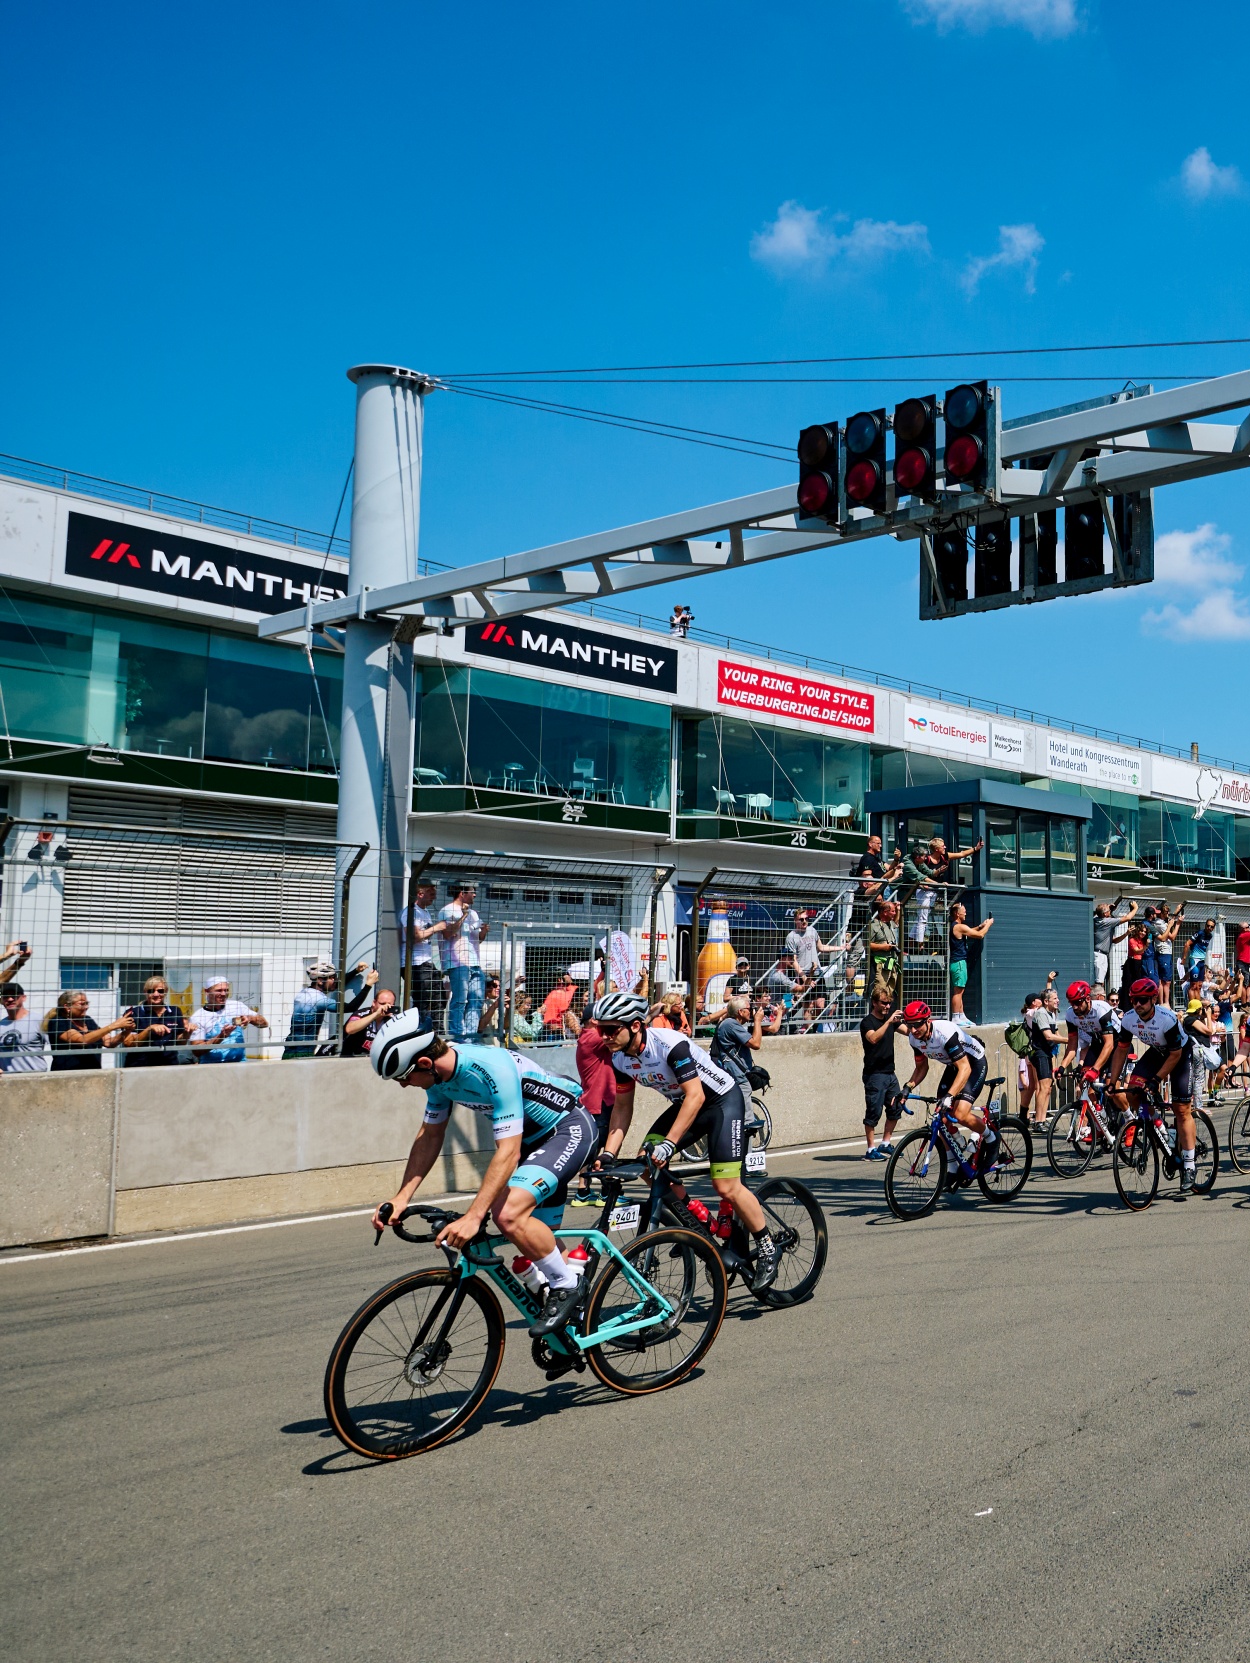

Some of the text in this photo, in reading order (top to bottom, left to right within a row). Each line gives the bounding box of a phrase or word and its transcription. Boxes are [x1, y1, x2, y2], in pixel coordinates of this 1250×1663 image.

[151, 549, 347, 604] MANTHE
[521, 630, 664, 676] MANTHEY
[724, 667, 870, 710] YOUR RING. YOUR STYLE.
[721, 687, 871, 728] NUERBURGRING.DE/SHOP
[929, 721, 987, 743] TotalEnergies
[1049, 740, 1140, 770] Hotel und Kongresszentrum
[1049, 755, 1088, 773] Wanderath
[791, 832, 807, 847] 26
[1092, 865, 1102, 878] 24
[1196, 877, 1205, 889] 23
[471, 1062, 499, 1095] MAISCH
[693, 1059, 727, 1087] annondale
[523, 1082, 570, 1109] STRASSACKER
[553, 1123, 582, 1172] STRASSACKER
[615, 1210, 636, 1222] 9401
[494, 1263, 541, 1320] Bianc
